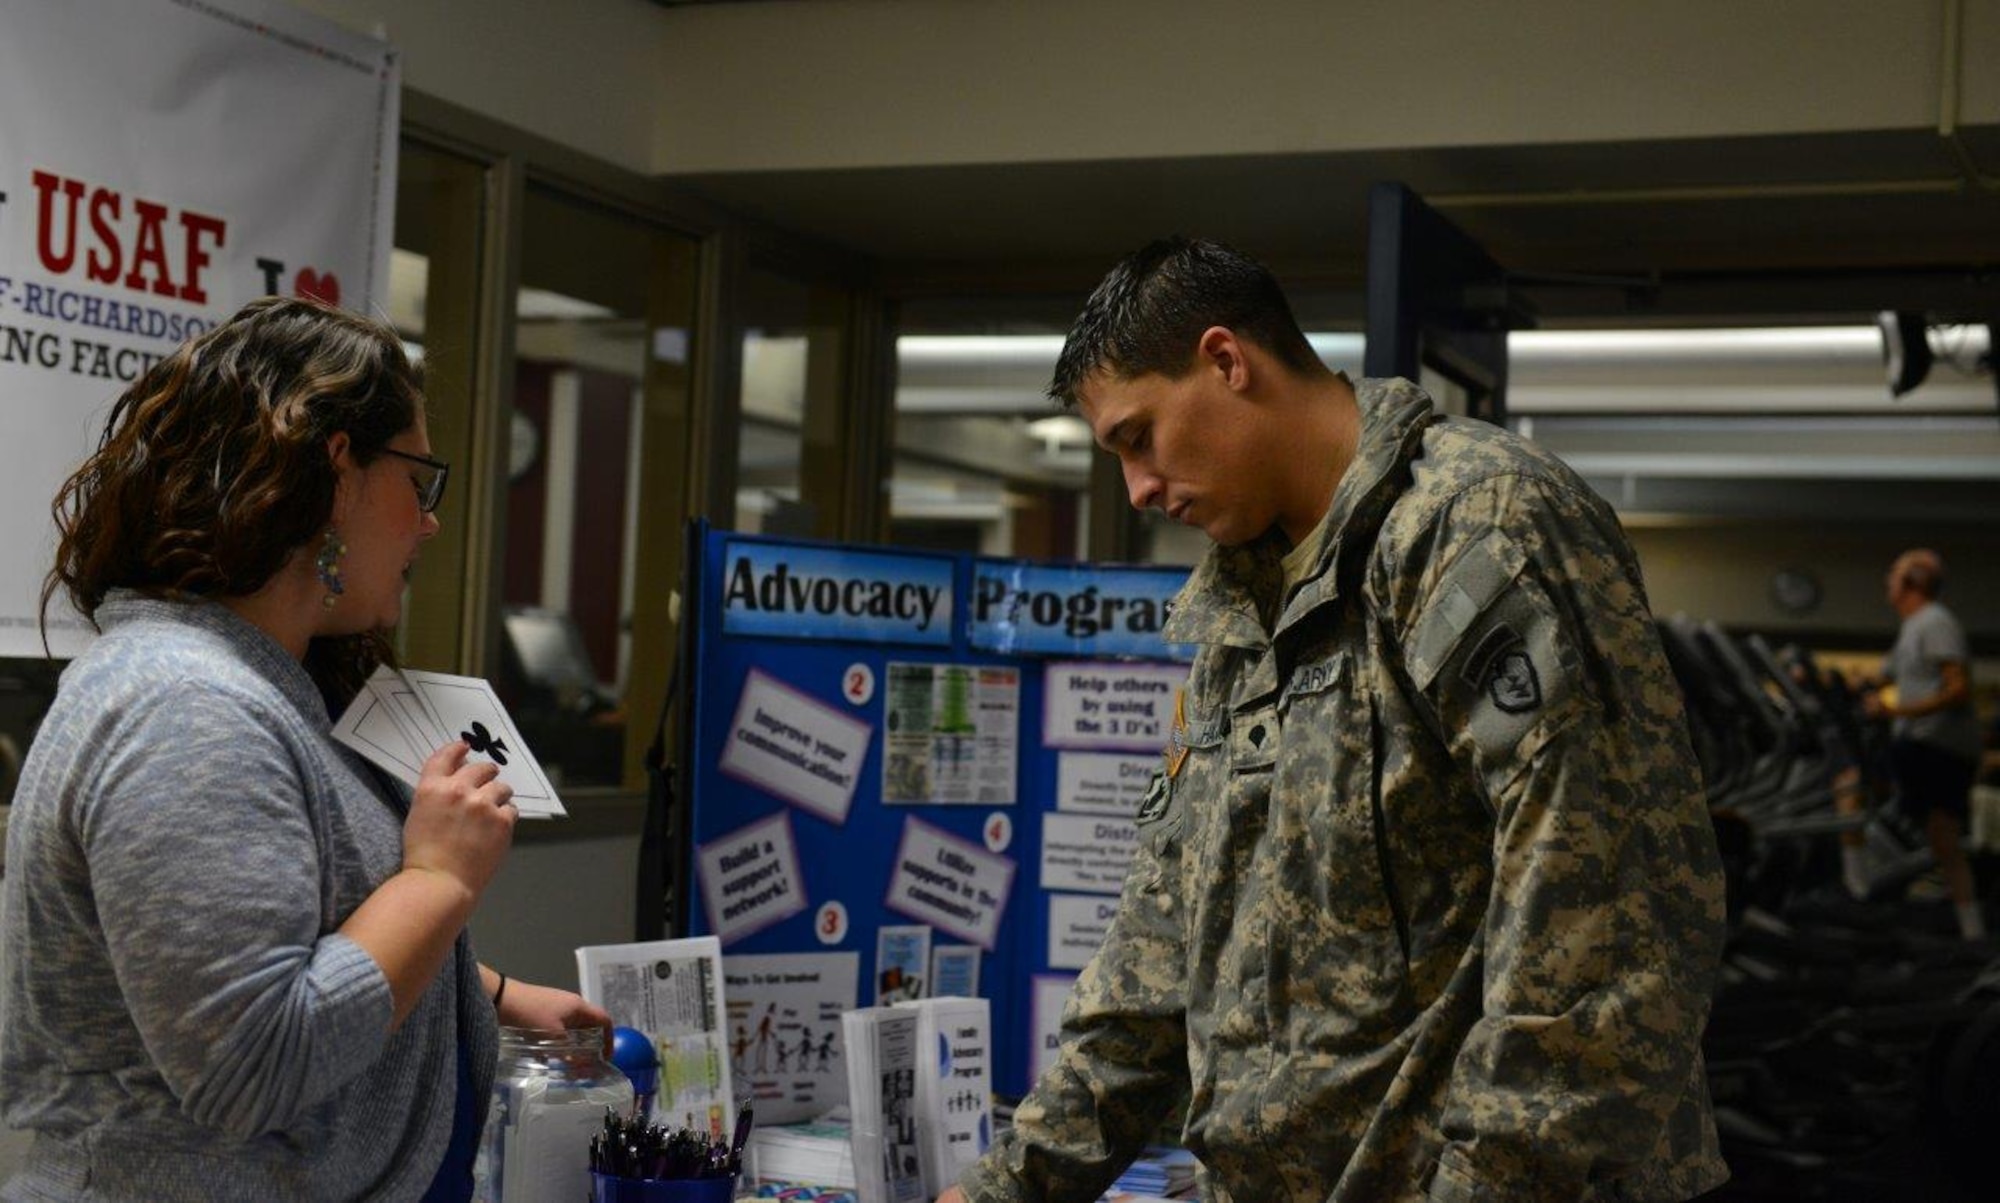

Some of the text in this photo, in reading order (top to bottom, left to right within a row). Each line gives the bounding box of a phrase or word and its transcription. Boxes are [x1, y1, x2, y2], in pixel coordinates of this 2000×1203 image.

[33, 170, 226, 304] USAF
[0, 278, 217, 342] F-RICHARDSO
[0, 325, 60, 368] NG
[726, 557, 1172, 638] Advocacy Progra
[850, 672, 864, 696] 2
[1069, 676, 1169, 693] Help others
[1075, 719, 1101, 733] the
[1108, 719, 1118, 733] 3
[1082, 699, 1154, 717] by using
[754, 707, 847, 762] Improve your
[737, 727, 852, 789] communication!
[989, 820, 1003, 841] 4
[720, 840, 774, 874] Build a
[903, 860, 958, 893] supports
[722, 858, 781, 897] support
[722, 877, 788, 921] network!
[907, 885, 982, 926] community!
[822, 910, 838, 935] 3
